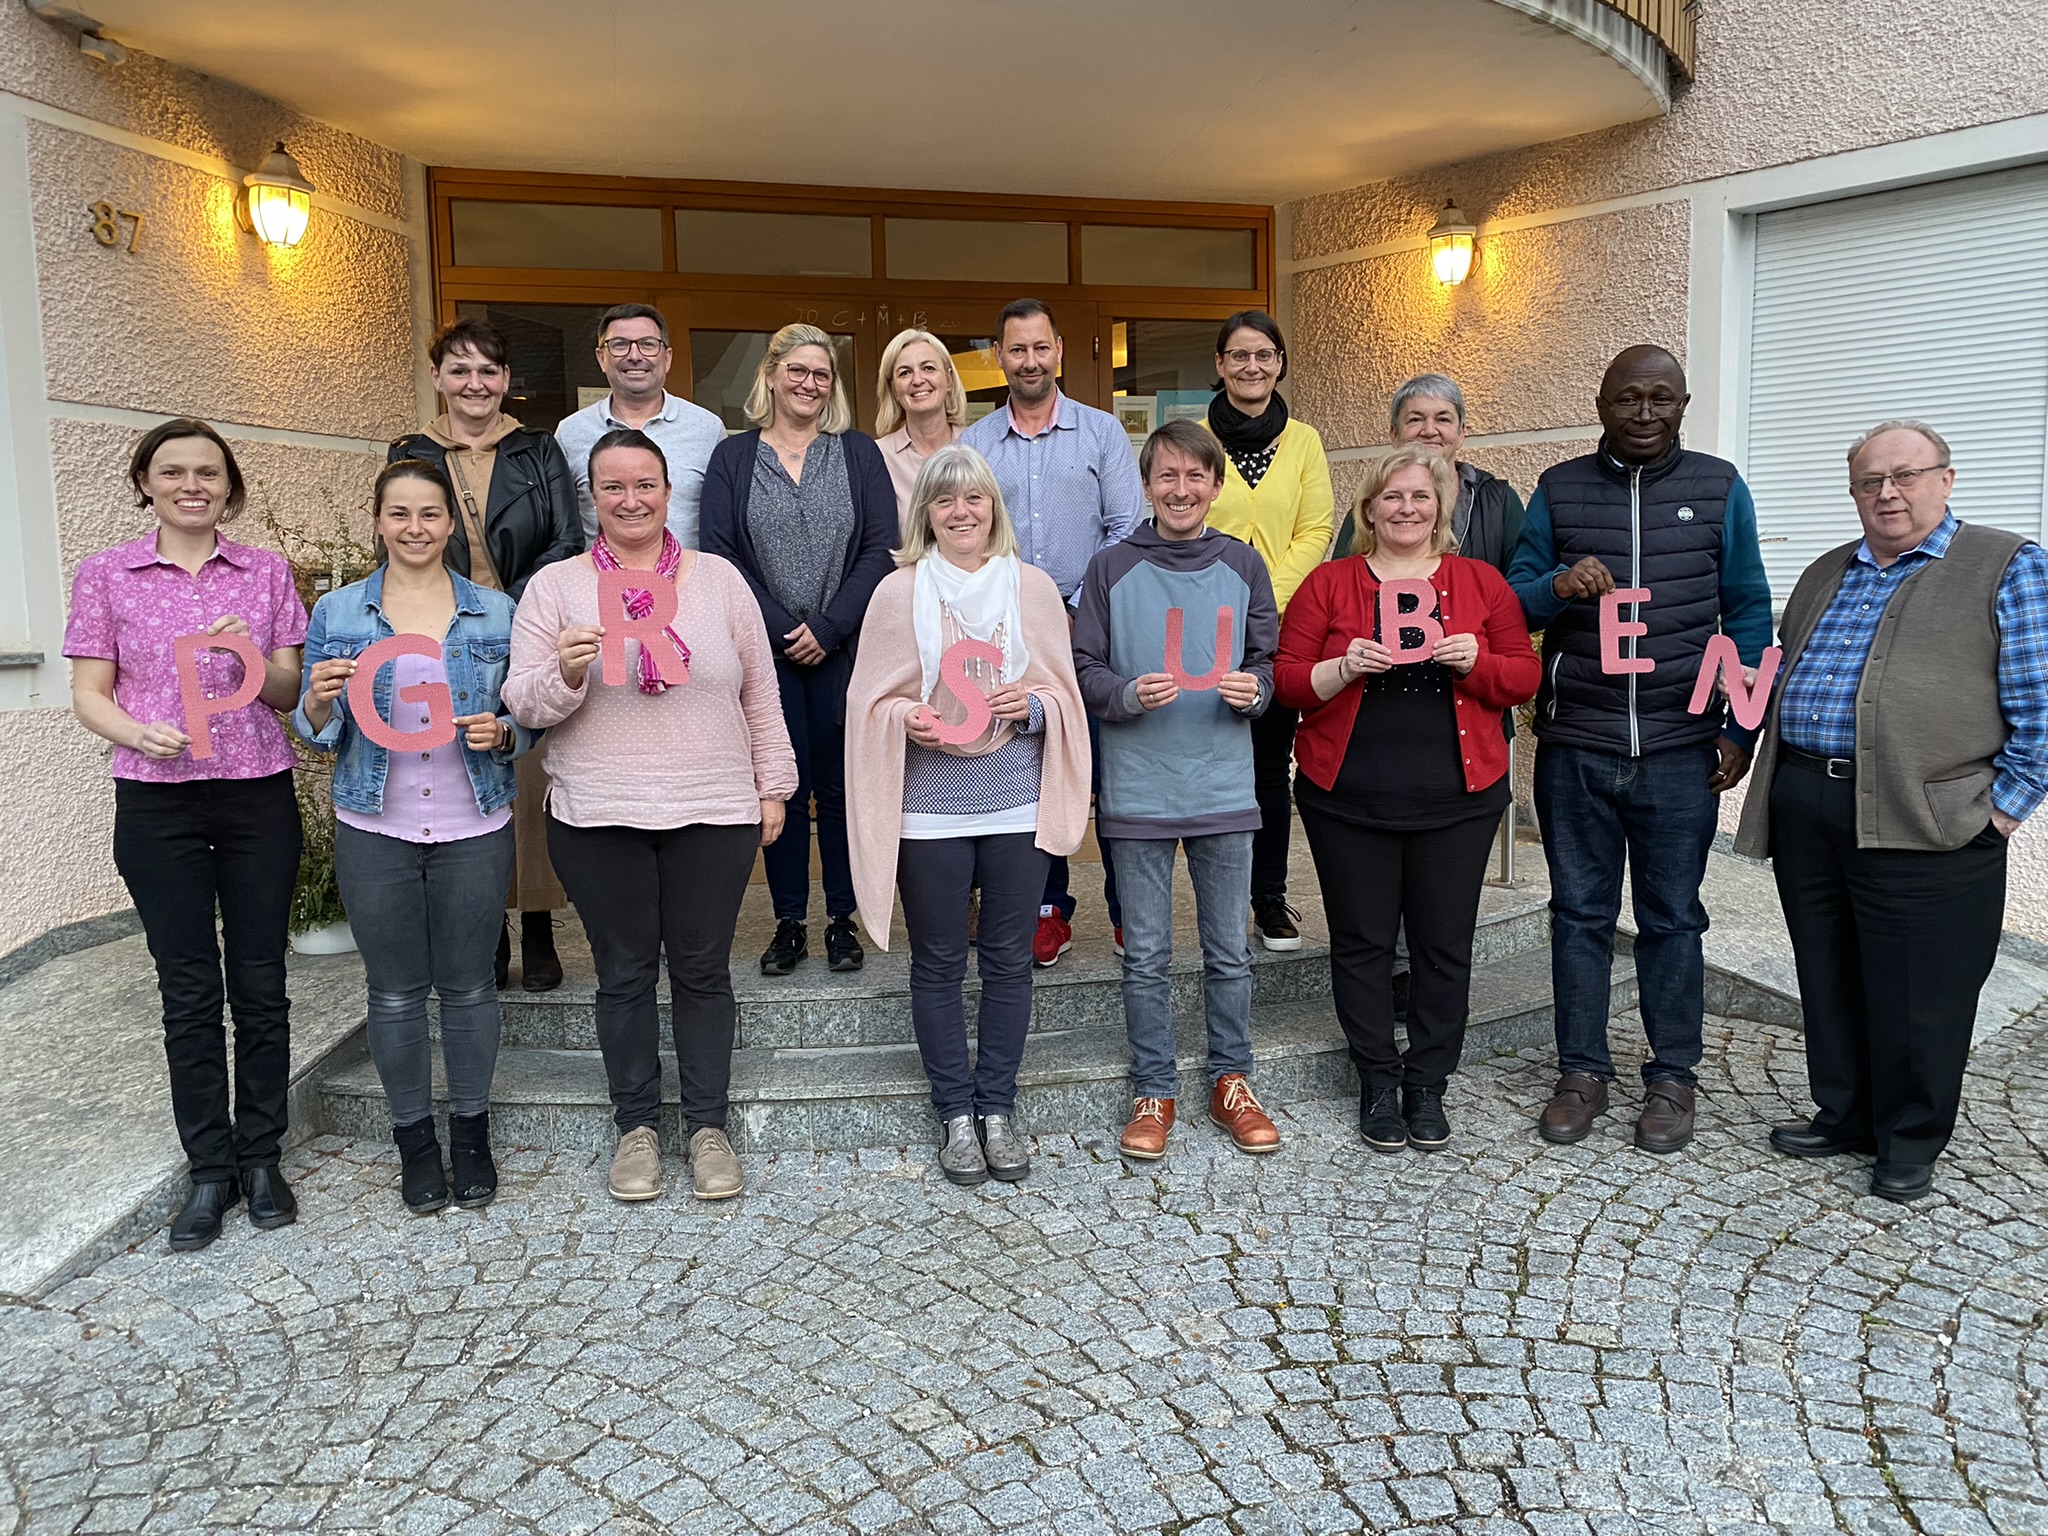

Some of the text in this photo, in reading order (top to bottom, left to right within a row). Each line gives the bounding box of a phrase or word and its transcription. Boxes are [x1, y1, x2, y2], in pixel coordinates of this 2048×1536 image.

[93, 200, 145, 254] 87
[831, 310, 850, 326] C
[912, 310, 928, 327] B
